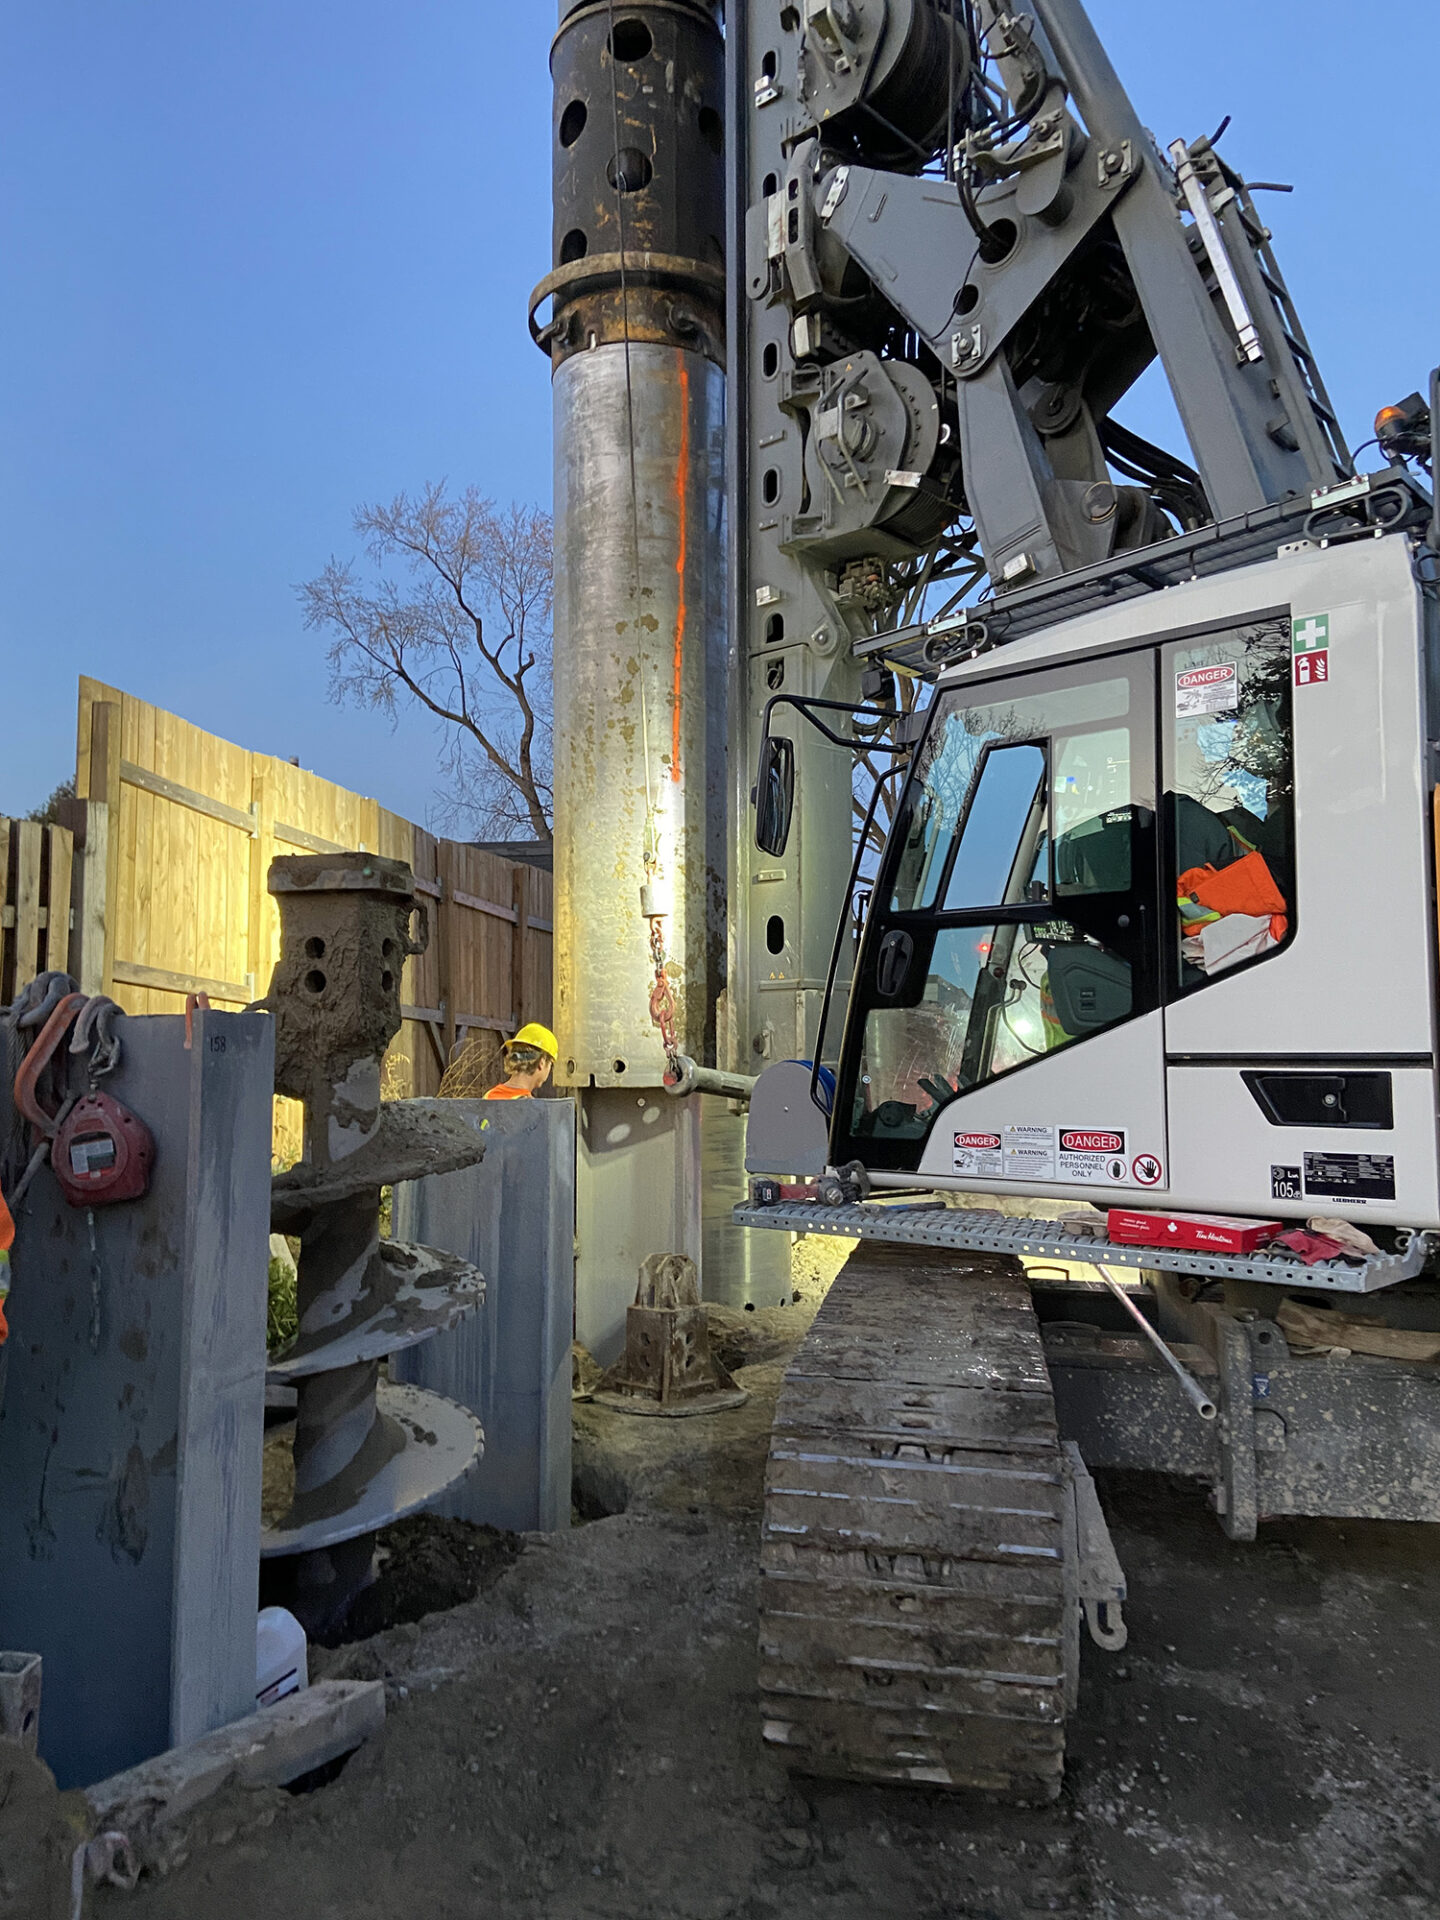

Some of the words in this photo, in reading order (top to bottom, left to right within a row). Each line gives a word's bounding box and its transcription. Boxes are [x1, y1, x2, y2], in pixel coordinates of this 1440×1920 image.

[1183, 669, 1228, 685] DANGER
[210, 1035, 226, 1053] 158
[1016, 1126, 1047, 1134] WARNING
[959, 1136, 996, 1146] DANGER
[1066, 1135, 1117, 1149] DANGER
[1017, 1149, 1047, 1157] WARNING
[1059, 1153, 1106, 1163] AUTHORIZED
[1060, 1162, 1104, 1171] PERSONNEL
[1072, 1170, 1092, 1178] ONLY
[1273, 1181, 1294, 1198] 105
